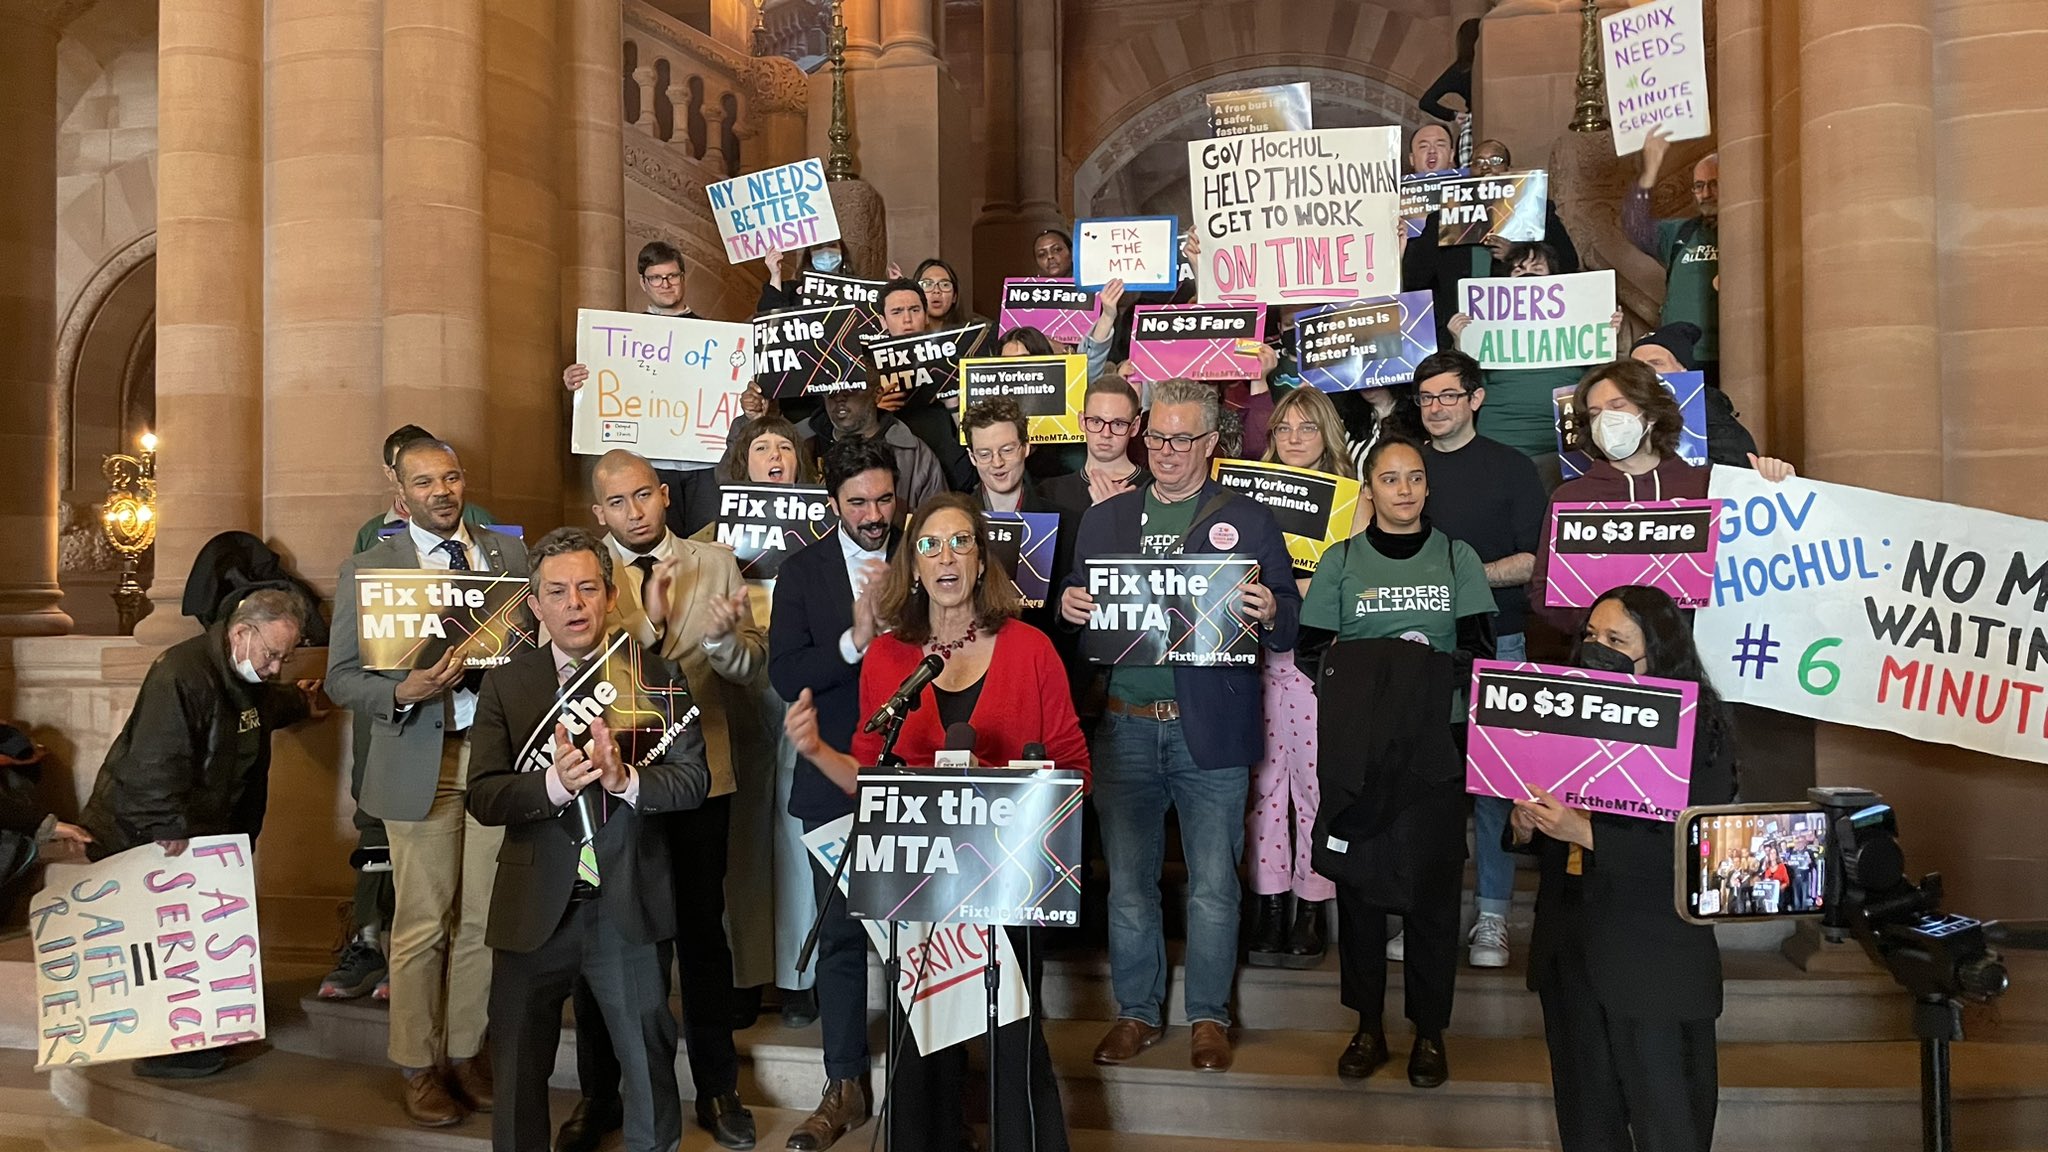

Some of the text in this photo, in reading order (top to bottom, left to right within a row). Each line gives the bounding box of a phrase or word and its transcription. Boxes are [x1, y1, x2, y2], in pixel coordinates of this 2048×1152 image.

[1609, 7, 1676, 43] BRONX
[1615, 32, 1686, 68] NEEDS
[1215, 104, 1223, 115] A
[1225, 102, 1246, 114] free
[1248, 100, 1267, 110] bus
[1619, 81, 1692, 115] MINUTE
[1216, 123, 1269, 137] faster bus
[1223, 114, 1253, 127] safer,
[1619, 99, 1694, 134] SERVICE!
[709, 161, 823, 210] NY NEEDS
[1204, 159, 1398, 210] HELP THIS WOMAN
[1401, 185, 1422, 195] free
[1441, 181, 1516, 204] Fix the
[731, 191, 816, 233] BETTER
[1208, 200, 1363, 239] GET TO WORK
[1400, 206, 1424, 216] aster
[1441, 204, 1489, 225] MTA
[727, 216, 819, 260] TRANSIT
[1111, 228, 1139, 241] FIX
[1112, 242, 1142, 254] THE
[1109, 258, 1146, 272] MTA
[1213, 243, 1257, 293] ON
[1681, 252, 1719, 264] ALLIA
[803, 276, 879, 303] Fix the
[1009, 287, 1087, 303] No $3 Fare
[1468, 283, 1565, 321] RIDERS
[754, 317, 824, 348] Fix the
[1141, 315, 1246, 333] No $3 Fare
[1304, 311, 1390, 336] A free bus is
[592, 327, 718, 370] Tired of
[1305, 332, 1355, 350] a safer,
[1305, 347, 1348, 364] faster
[1350, 343, 1378, 357] bus
[1479, 322, 1612, 363] ALLIANCE
[754, 347, 802, 375] MTA
[873, 340, 957, 370] Fix the
[807, 379, 867, 394] FixtheMTA.org
[879, 366, 934, 393] MTA
[970, 371, 1044, 383] New Yorkers
[970, 383, 1056, 396] need 6-minute
[1365, 372, 1414, 386] FixtheMT
[598, 369, 743, 437] Being LAT
[1030, 433, 1085, 442] xtheMTA.org
[1221, 474, 1252, 488] New
[1254, 477, 1309, 497] Yorkers
[719, 492, 826, 522] Fix the
[1255, 492, 1319, 514] 6-minute
[1718, 491, 1816, 543] GOV
[716, 522, 787, 551] MTA
[997, 529, 1012, 541] is
[1563, 519, 1696, 543] No $3 Fare
[1089, 567, 1209, 596] Fix the
[1714, 537, 1891, 607] HOCHUL:
[1901, 539, 1986, 604] NO
[360, 582, 485, 609] Fix the
[1356, 597, 1450, 614] ALLIANCE
[1378, 584, 1450, 600] RIDERS
[362, 613, 447, 639] MTA
[1089, 603, 1168, 631] MTA
[1168, 651, 1256, 664] FixtheMTA.org
[557, 680, 617, 736] the
[1484, 684, 1660, 728] No $3 Fare
[1877, 654, 2048, 739] MINUT
[636, 705, 700, 766] ixtheMTA.org
[858, 786, 1017, 826] Fix the
[1565, 791, 1681, 819] FixtheMTA.org
[855, 835, 959, 874] MTA
[71, 878, 139, 1053] SAFER
[144, 869, 206, 1050] SERVICE
